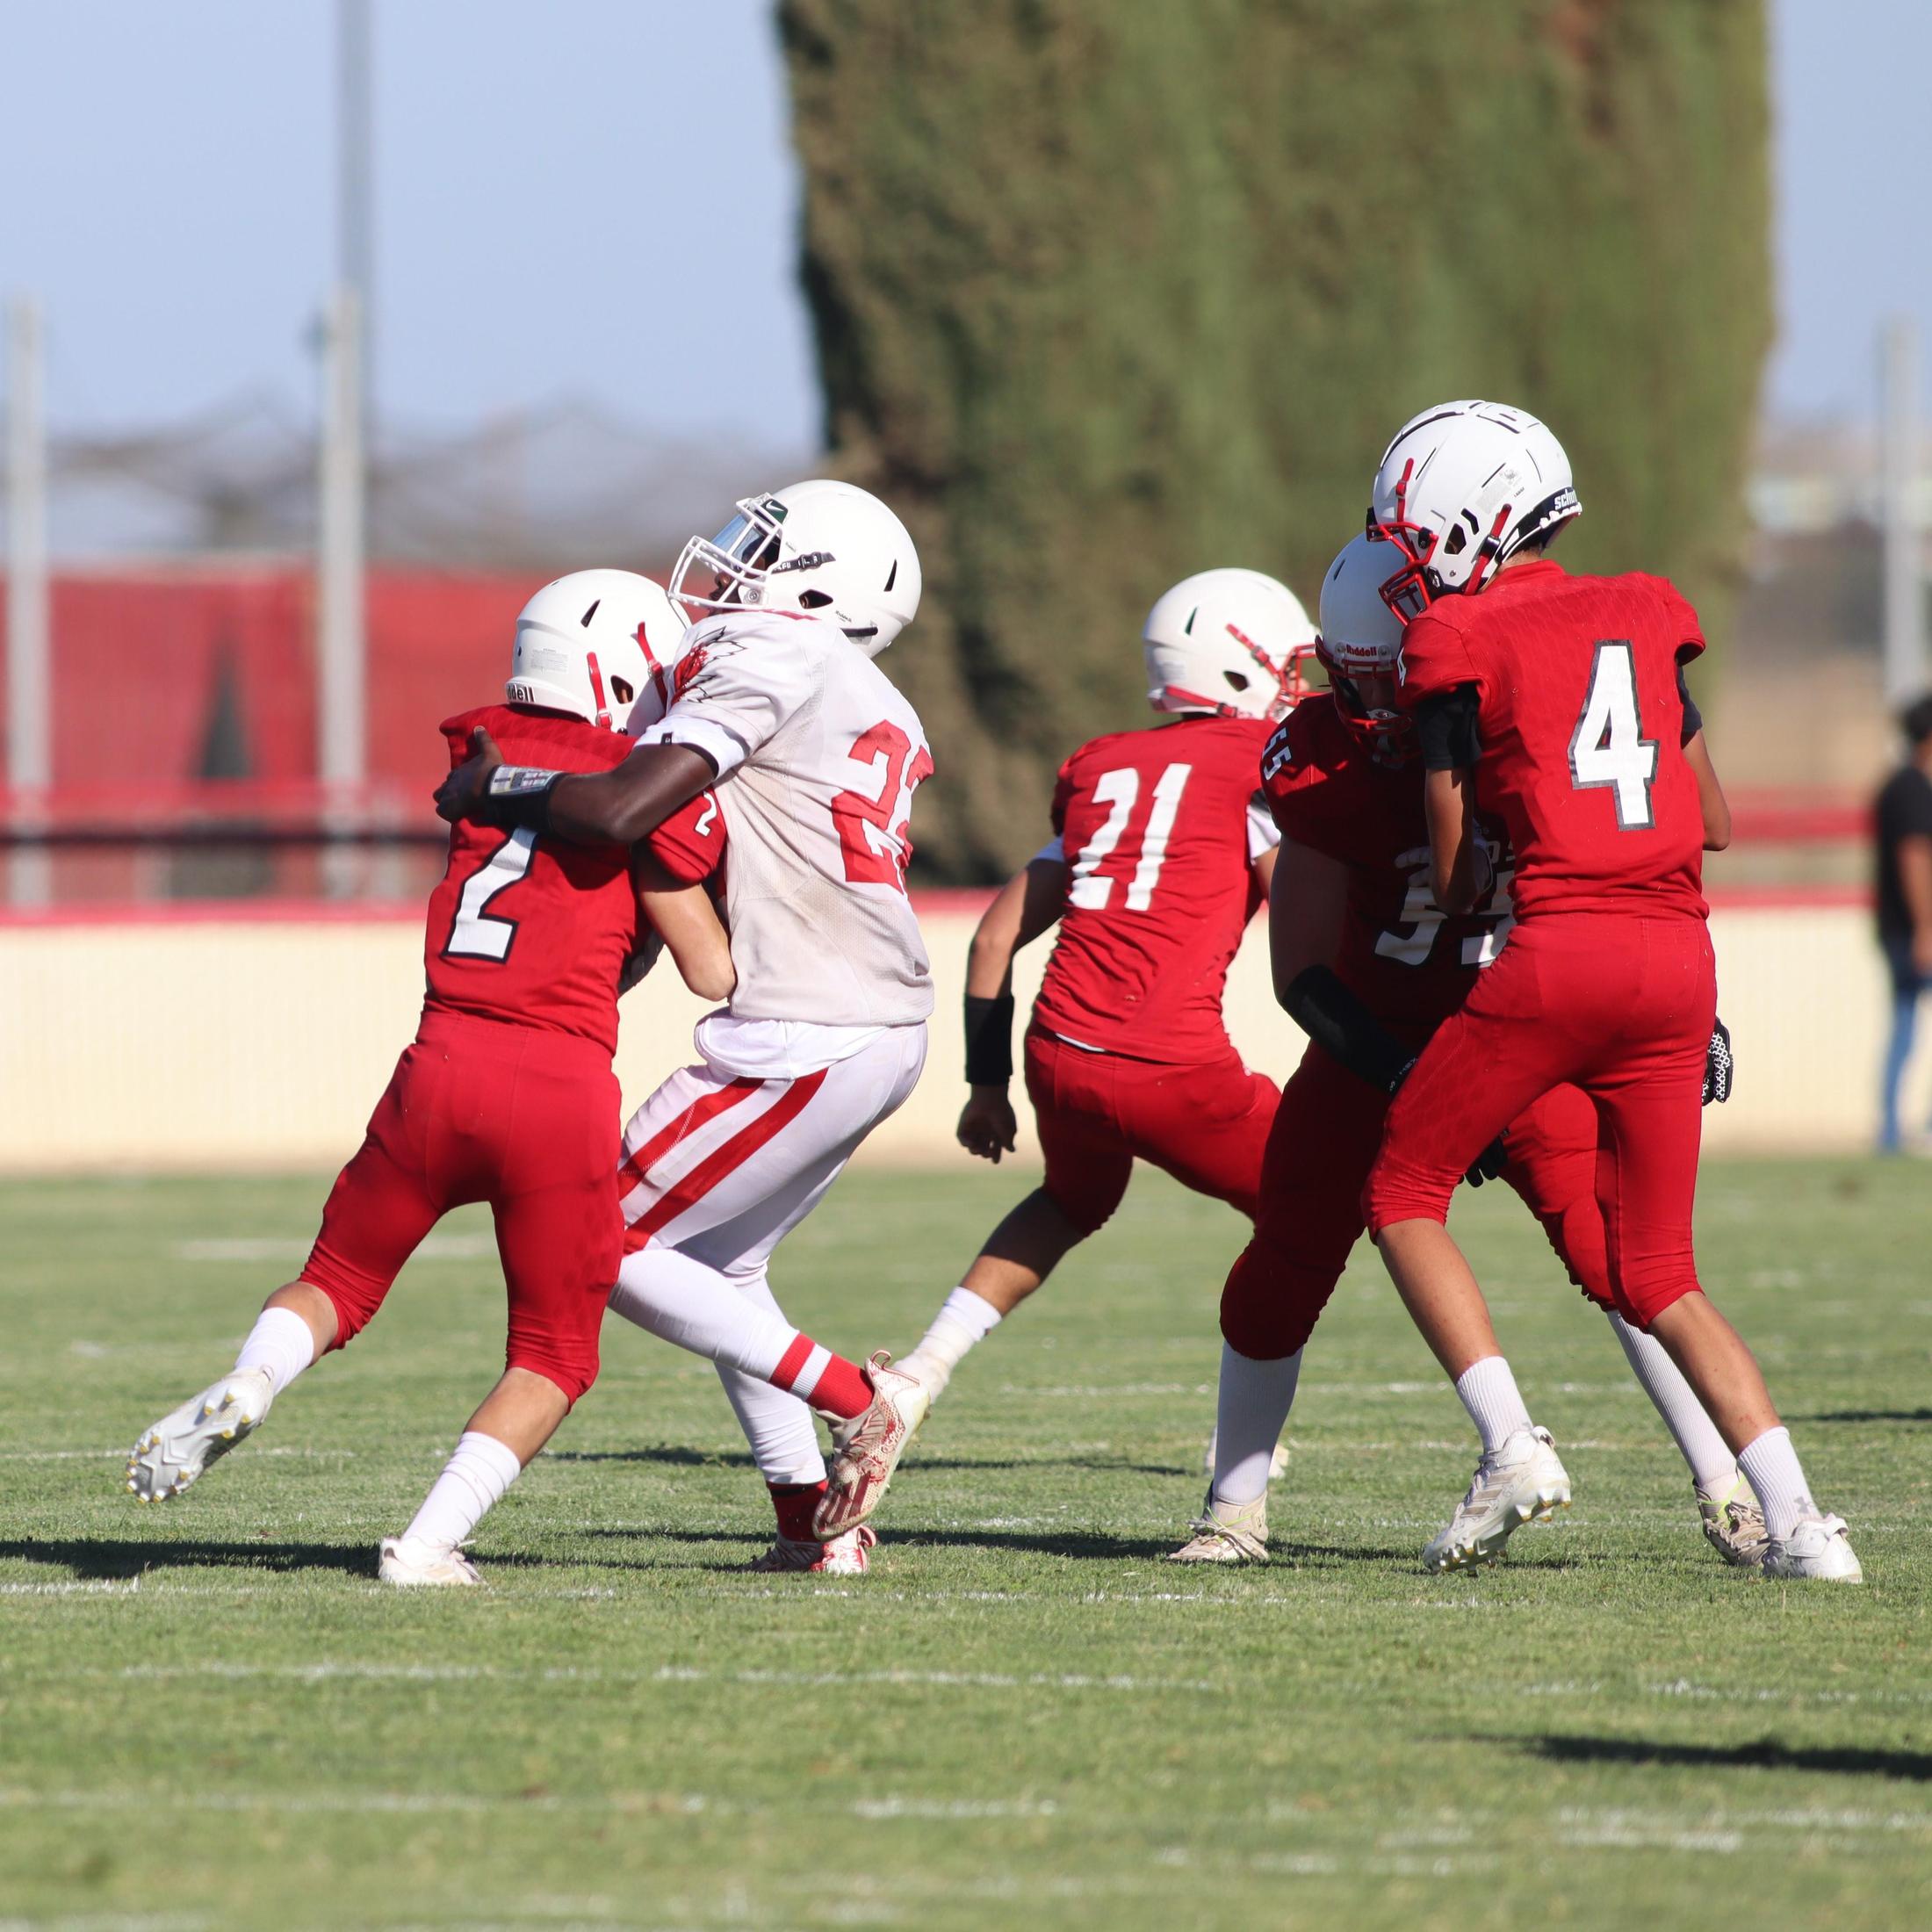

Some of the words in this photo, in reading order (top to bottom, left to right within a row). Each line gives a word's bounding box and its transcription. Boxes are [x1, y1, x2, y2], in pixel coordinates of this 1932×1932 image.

[1346, 644, 1377, 657] Riddell
[1261, 726, 1292, 781] 55
[1567, 639, 1660, 831] 4
[695, 789, 717, 836] 2
[1068, 762, 1192, 911] 21
[441, 824, 538, 964] 2
